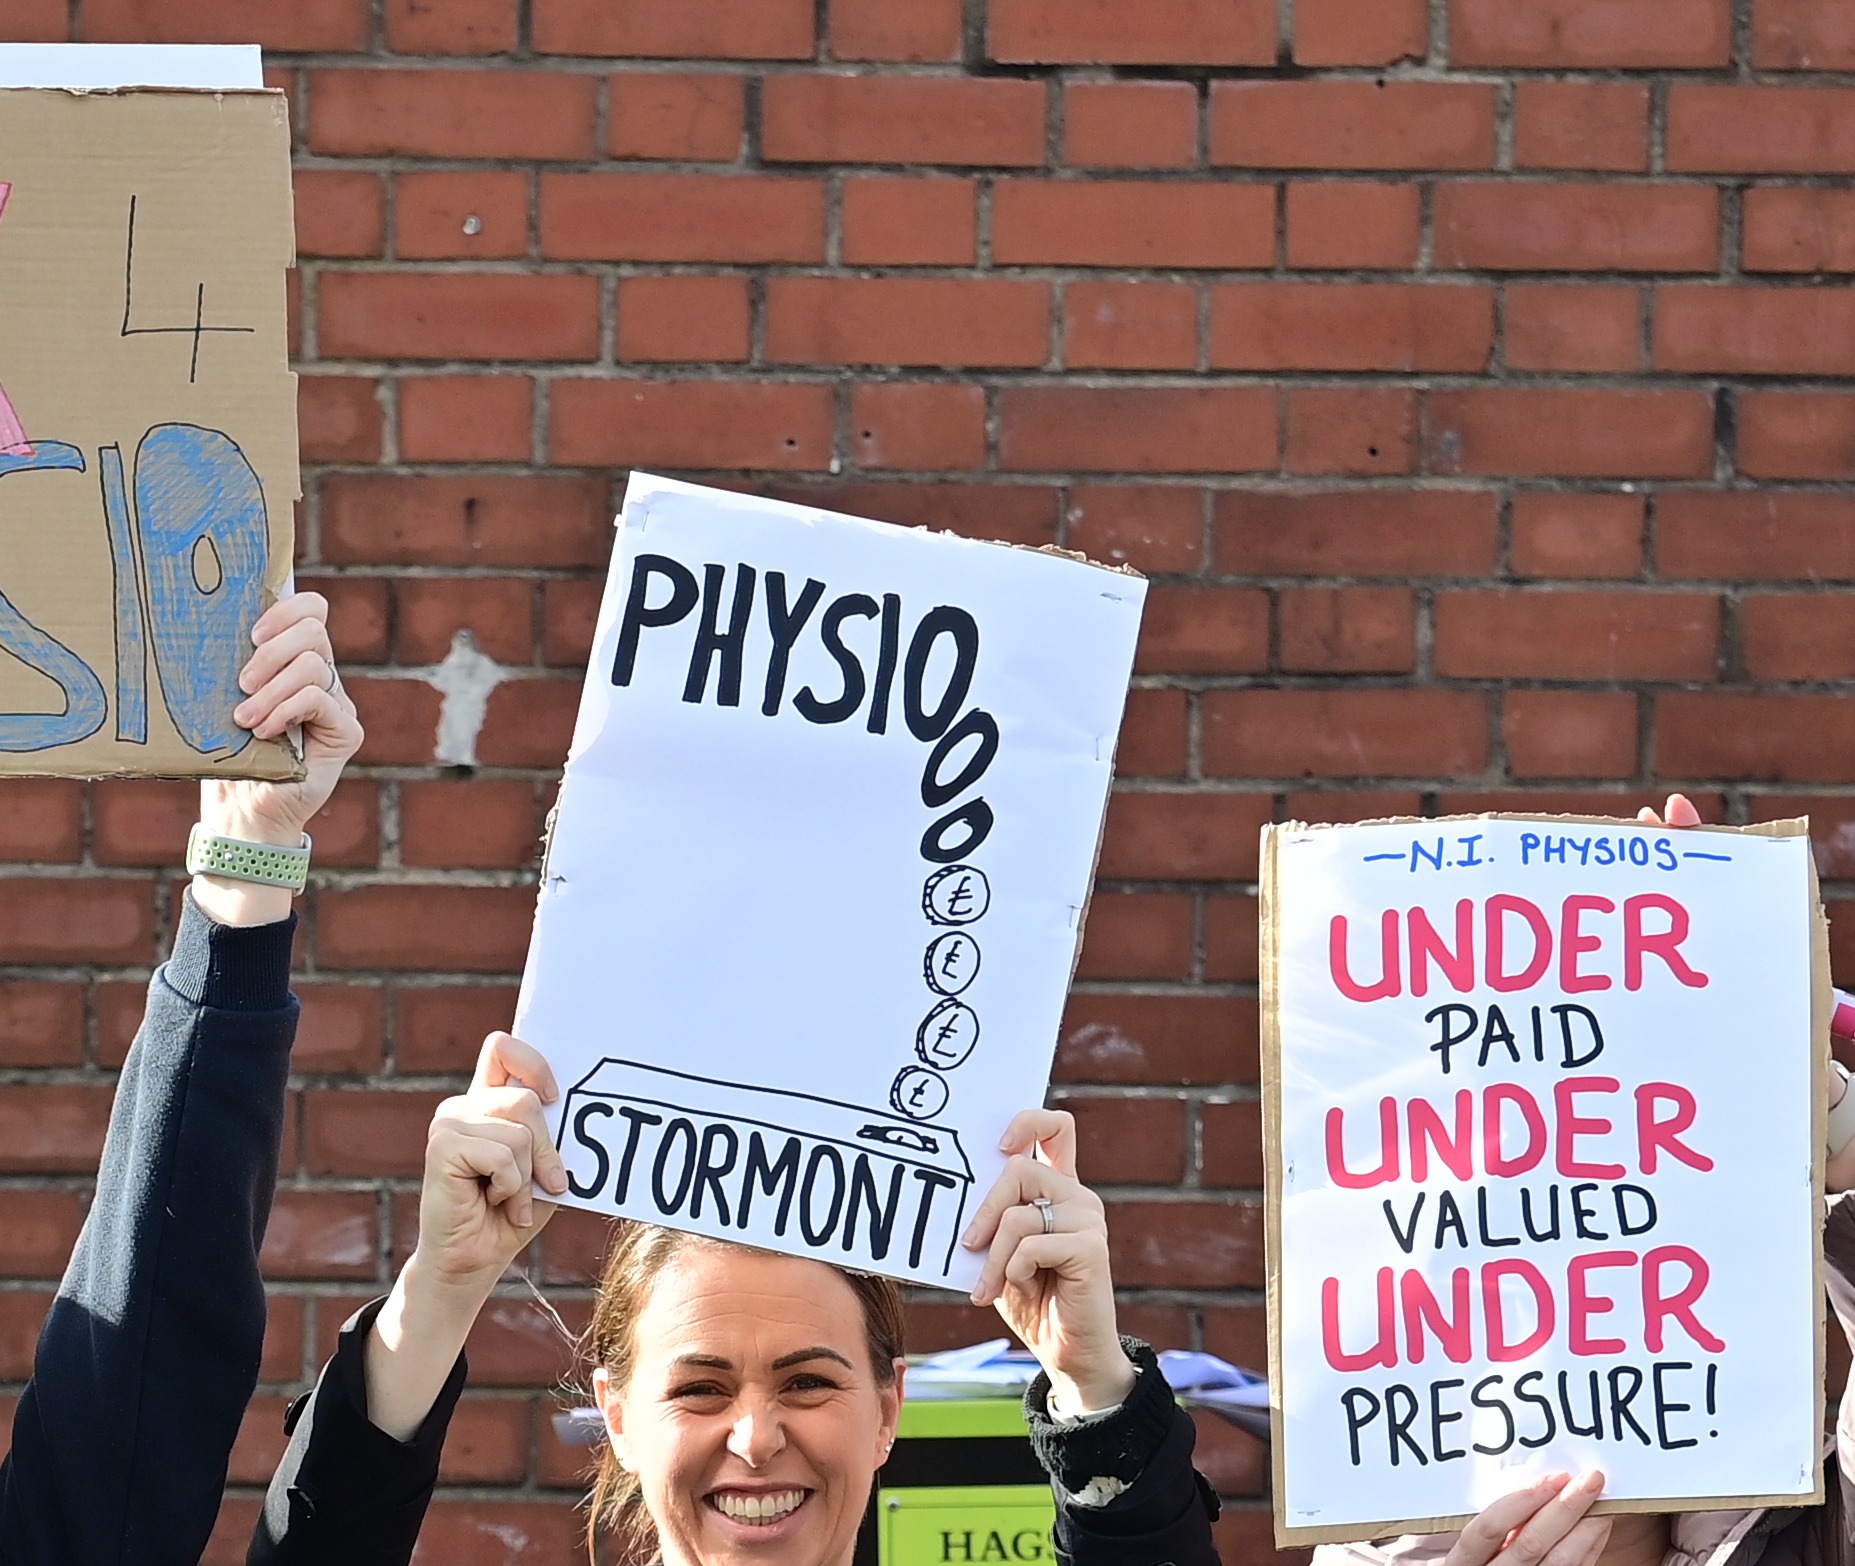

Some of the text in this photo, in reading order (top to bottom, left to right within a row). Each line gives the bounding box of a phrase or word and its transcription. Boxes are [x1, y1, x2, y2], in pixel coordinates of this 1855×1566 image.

[121, 195, 255, 383] 4
[1329, 893, 1710, 1002] UNDER
[1425, 1003, 1605, 1074] PAID
[566, 1100, 957, 1270] STORMONT
[1325, 1076, 1714, 1190] UNDER
[1382, 1182, 1659, 1253] VALUED
[1320, 1244, 1726, 1372] UNDER
[1341, 1361, 1722, 1467] PRESSURE!
[940, 1528, 1055, 1563] HAG
